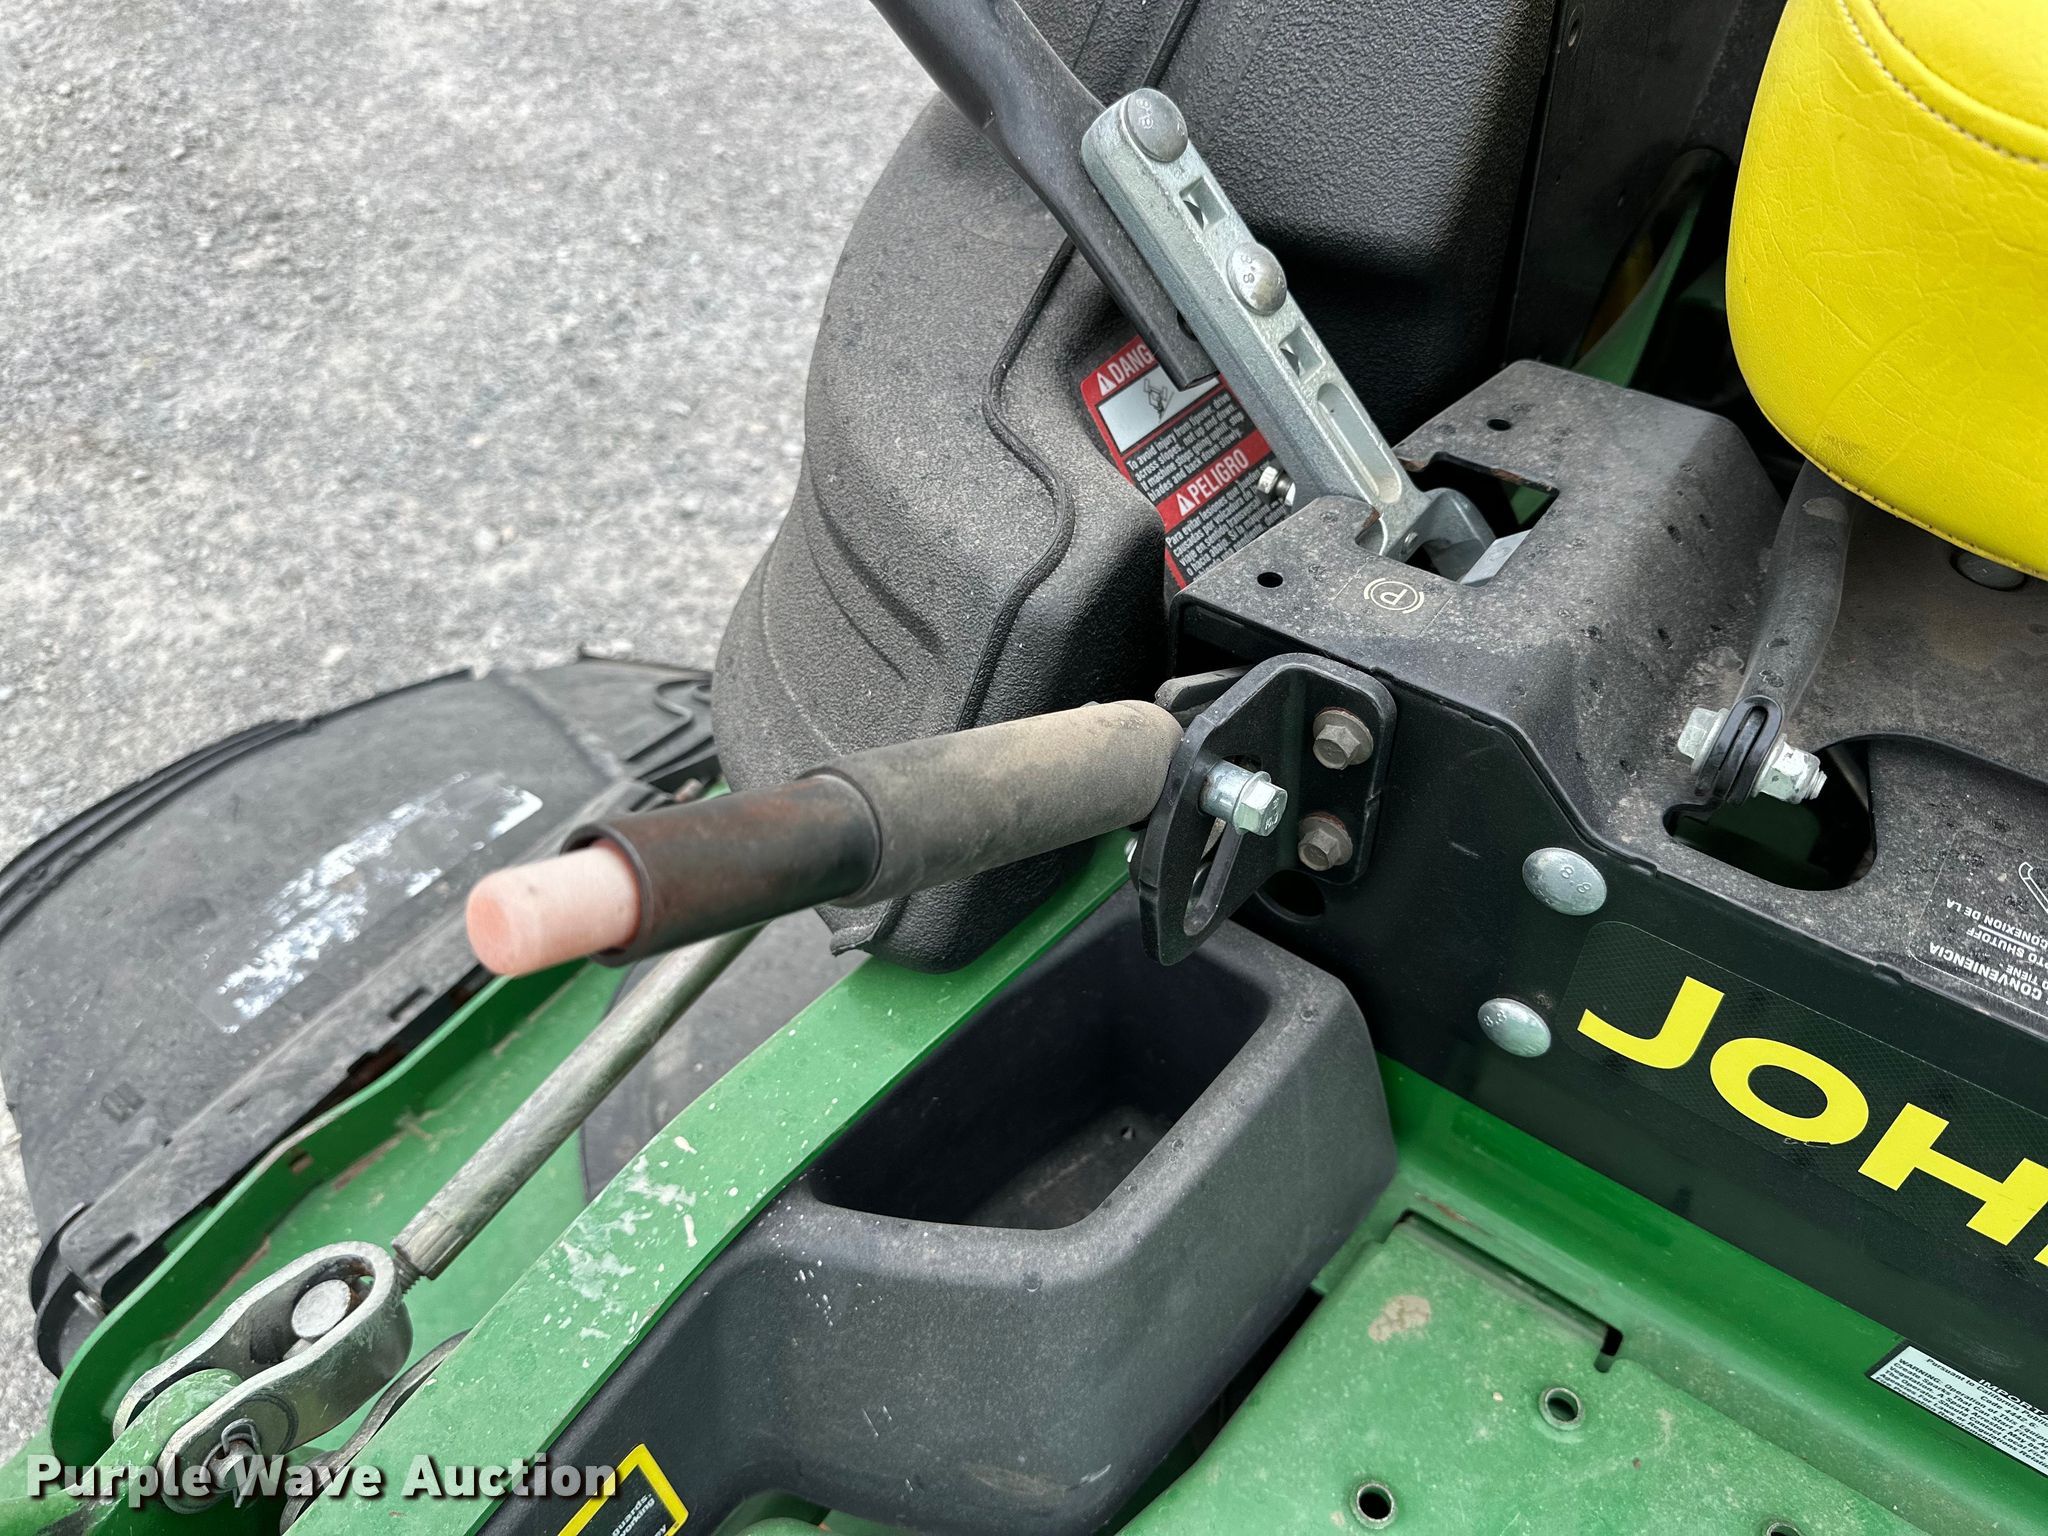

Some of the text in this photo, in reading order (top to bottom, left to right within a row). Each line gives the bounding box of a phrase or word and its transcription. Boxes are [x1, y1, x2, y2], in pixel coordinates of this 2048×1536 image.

[1107, 344, 1154, 384] DANG
[1127, 460, 1137, 471] To
[1136, 445, 1156, 464] avoid
[1155, 431, 1177, 453] injury
[1174, 421, 1191, 437] from
[1134, 460, 1159, 481] across
[1182, 432, 1196, 445] not
[1195, 427, 1205, 438] up
[1203, 417, 1217, 431] and
[1147, 462, 1176, 487] machine
[1175, 449, 1194, 467] stops
[1192, 437, 1212, 456] going
[1147, 478, 1173, 501] blades
[1171, 469, 1186, 484] and
[1184, 457, 1202, 474] back
[1200, 443, 1220, 461] down
[1187, 449, 1249, 504] PELIGRO
[1165, 530, 1183, 548] Para
[1181, 516, 1203, 535] evitar
[1199, 496, 1229, 521] lesiones
[1226, 487, 1240, 502] que
[1171, 530, 1205, 557] causadas
[1203, 522, 1216, 535] por
[1213, 498, 1245, 524] volcadura
[1178, 549, 1198, 568] viaje
[1196, 543, 1205, 553] en
[1204, 524, 1230, 546] sentido
[1191, 554, 1212, 572] hacia
[1945, 898, 1962, 911] LA
[1964, 906, 1981, 920] DE
[1966, 925, 2025, 957] SHUTOFF
[1929, 941, 2043, 1001] CONVENIENCIA
[2006, 964, 2039, 985] TIENE
[1577, 976, 2048, 1267] JOH
[1893, 1362, 1921, 1378] Create
[1922, 1378, 1951, 1395] Sparks
[1953, 1395, 1972, 1406] That
[1973, 1406, 1990, 1416] Can
[1991, 1416, 2013, 1428] Start
[2014, 1429, 2036, 1442] Fires
[1926, 1358, 1965, 1381] Pursuant
[1976, 1385, 2020, 1410] California
[1943, 1383, 1987, 1408] Operation
[1999, 1413, 2018, 1425] This
[1980, 1395, 2003, 1409] Code
[1880, 1373, 1916, 1394] Agencies
[1918, 1394, 1932, 1402] For
[1934, 1403, 1955, 1415] Laws
[1967, 1421, 2018, 1450] Regulations
[1885, 1370, 1900, 1379] The
[1901, 1379, 1936, 1399] Operator
[1938, 1399, 1968, 1416] Should
[1969, 1416, 2001, 1435] Contact
[2003, 1435, 2026, 1449] Local
[1945, 1397, 1970, 1412] Spark
[2007, 1431, 2026, 1442] May
